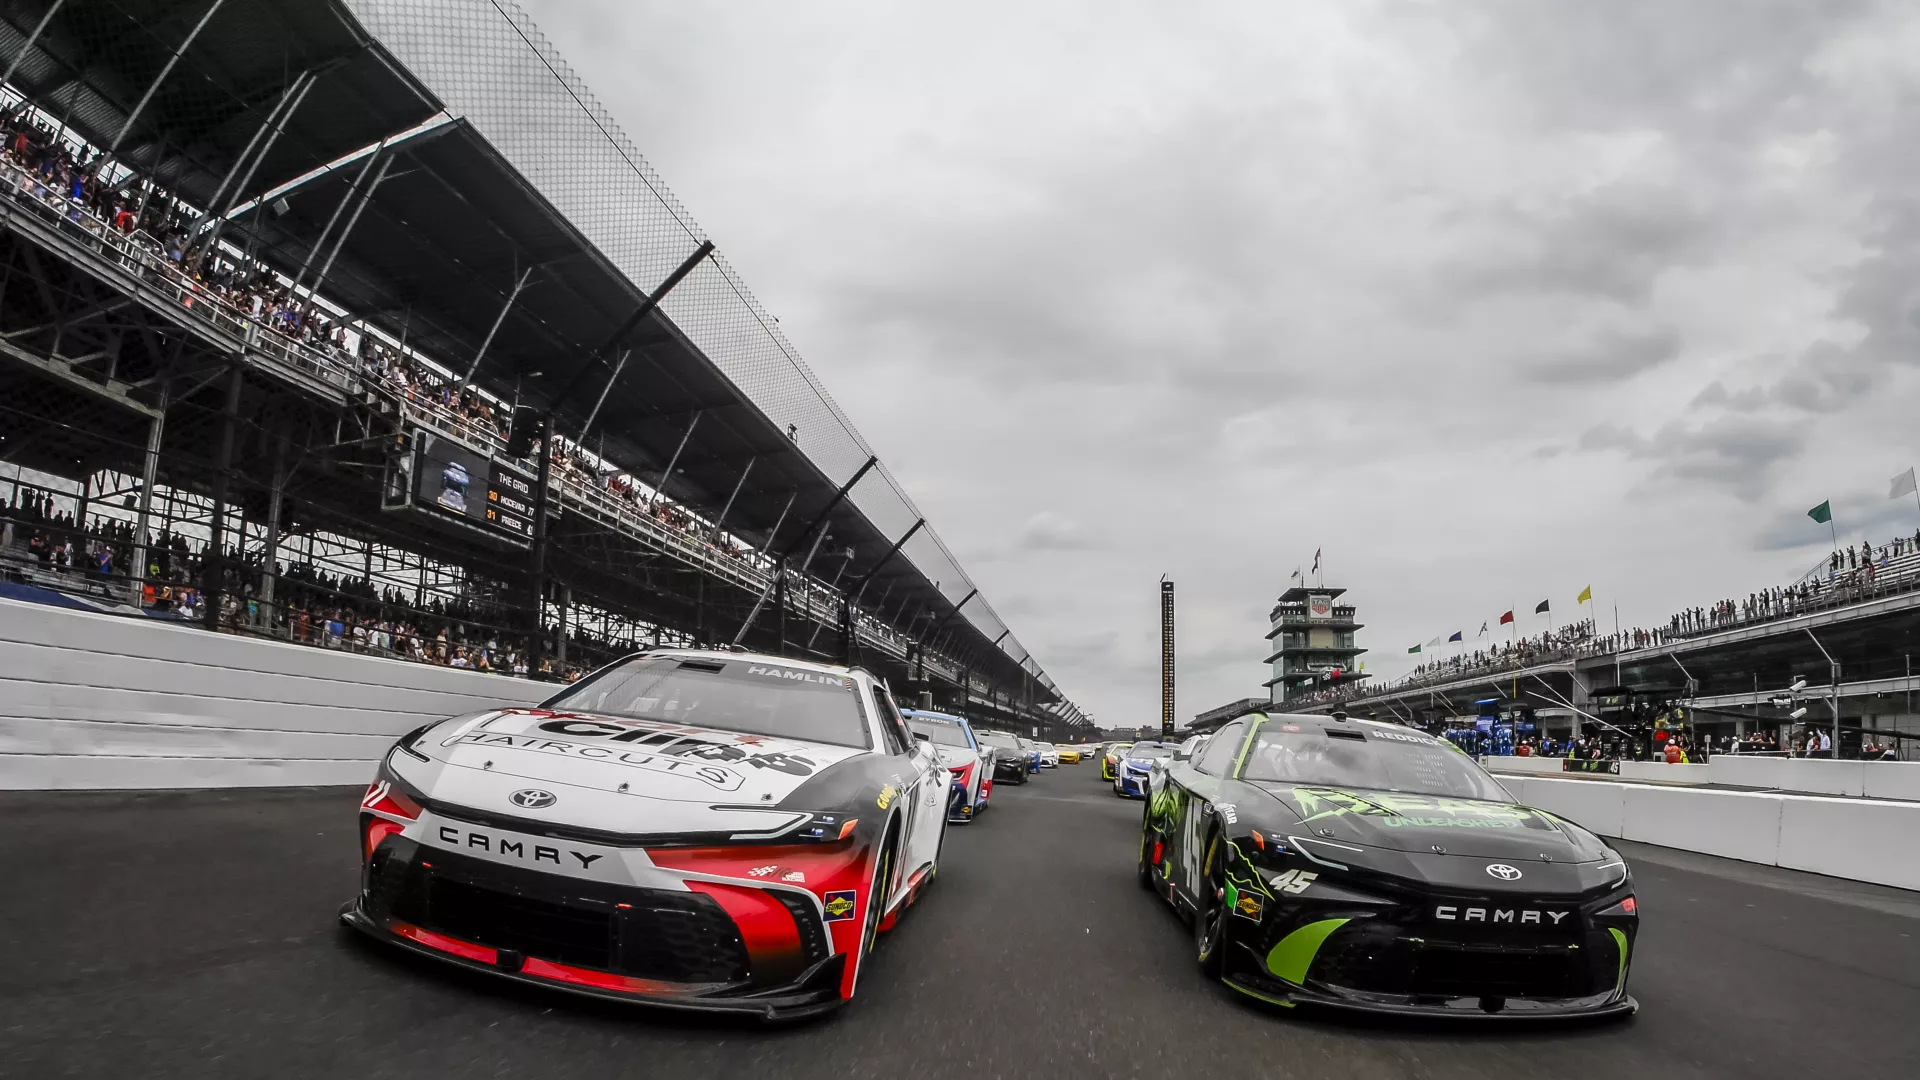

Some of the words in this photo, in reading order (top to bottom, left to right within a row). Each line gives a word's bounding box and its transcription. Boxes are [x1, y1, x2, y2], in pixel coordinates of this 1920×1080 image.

[499, 472, 512, 487] THE
[512, 479, 529, 494] GRID
[488, 490, 498, 501] 30
[487, 509, 496, 520] 31
[747, 666, 843, 687] HAMLIN
[918, 717, 950, 725] BYRON
[1372, 730, 1444, 747] REDDICK
[462, 733, 730, 785] HAIRCUTS
[1610, 761, 1620, 774] 45
[1382, 816, 1519, 828] UNLEASHED
[440, 826, 604, 869] CAMRY
[1269, 868, 1319, 894] 45
[826, 901, 854, 912] SUNOCO
[1436, 905, 1570, 925] CAMRY
